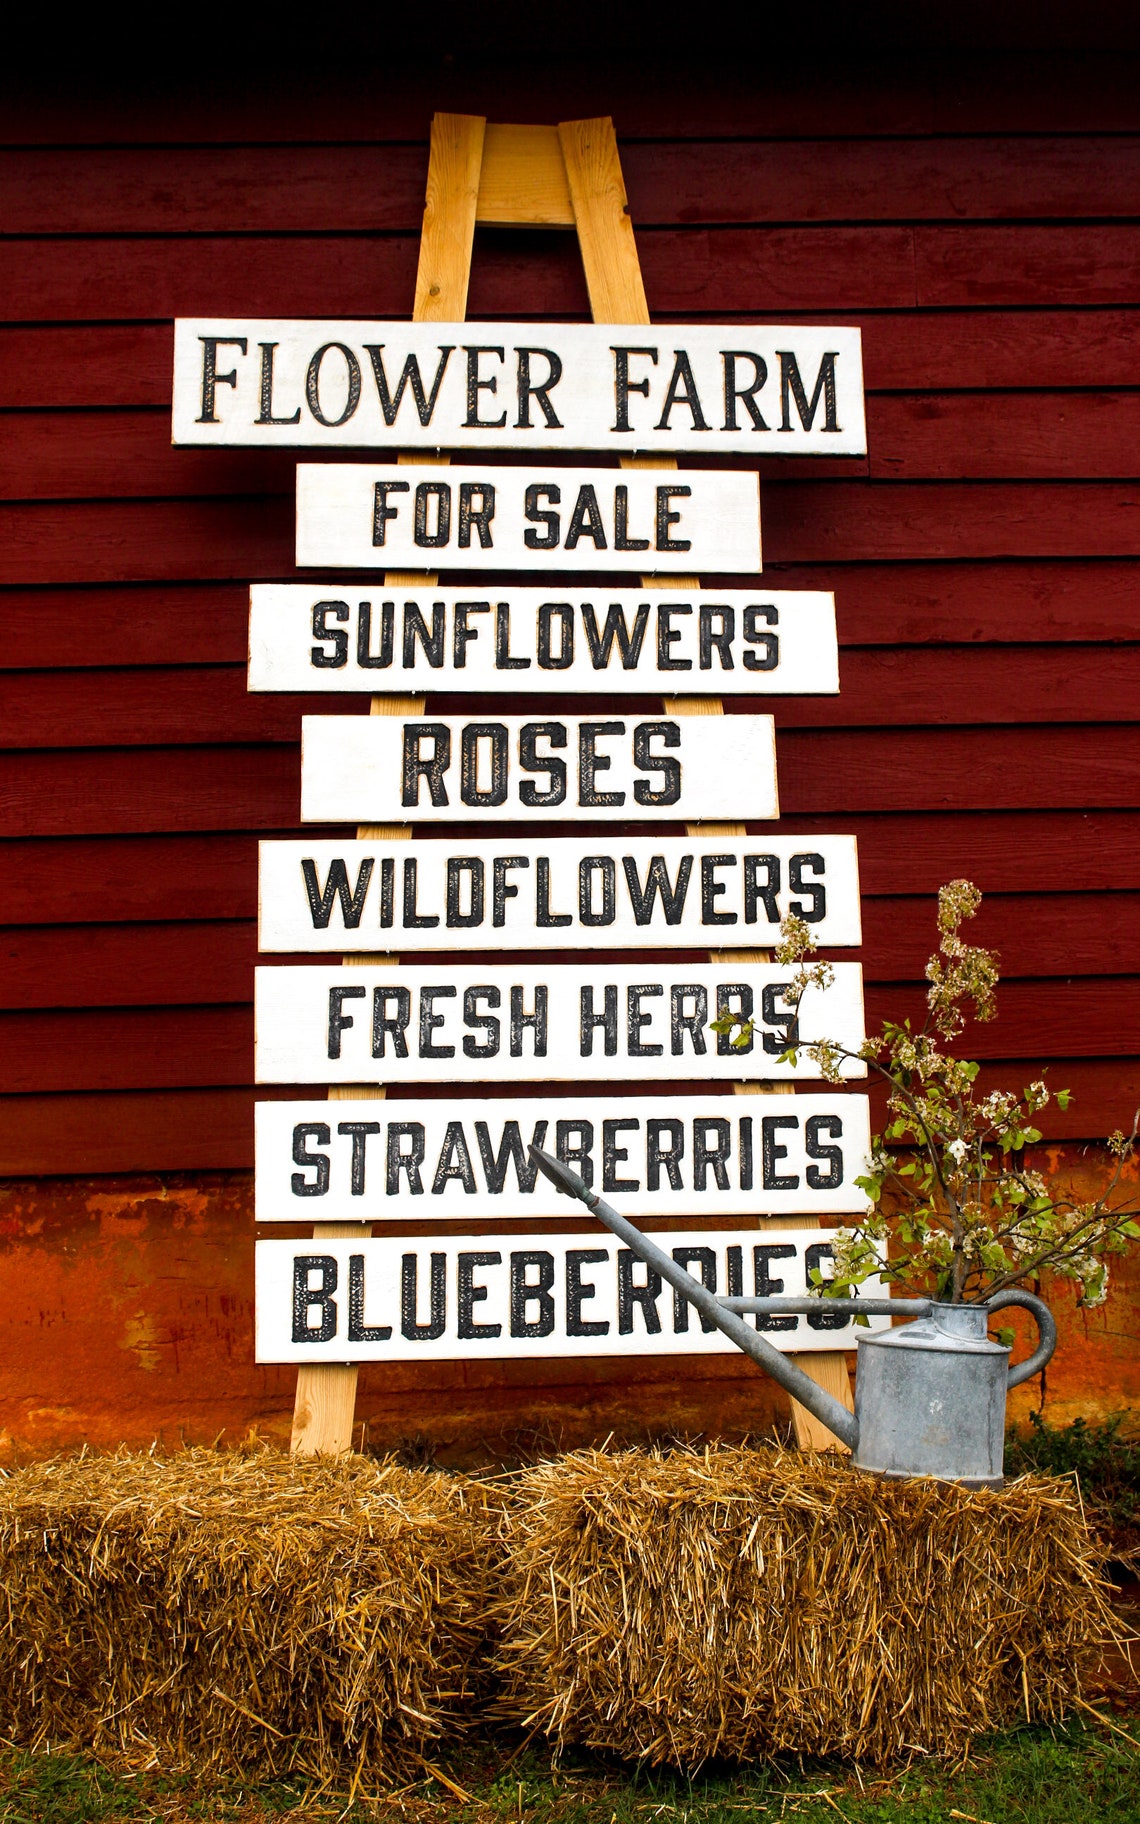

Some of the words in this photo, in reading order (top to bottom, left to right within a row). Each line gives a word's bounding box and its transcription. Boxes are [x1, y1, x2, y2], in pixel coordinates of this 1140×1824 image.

[195, 334, 565, 432] FLOWER
[608, 344, 843, 434] FARM
[371, 480, 496, 548] FOR
[523, 483, 692, 552] SALE
[309, 599, 781, 671] SUNFLOWERS
[401, 721, 682, 808] ROSES
[301, 852, 827, 929] WILDFLOWERS
[327, 983, 548, 1060] FRESH
[579, 982, 800, 1058] HERBS
[291, 1114, 844, 1197] STRAWBERRIES
